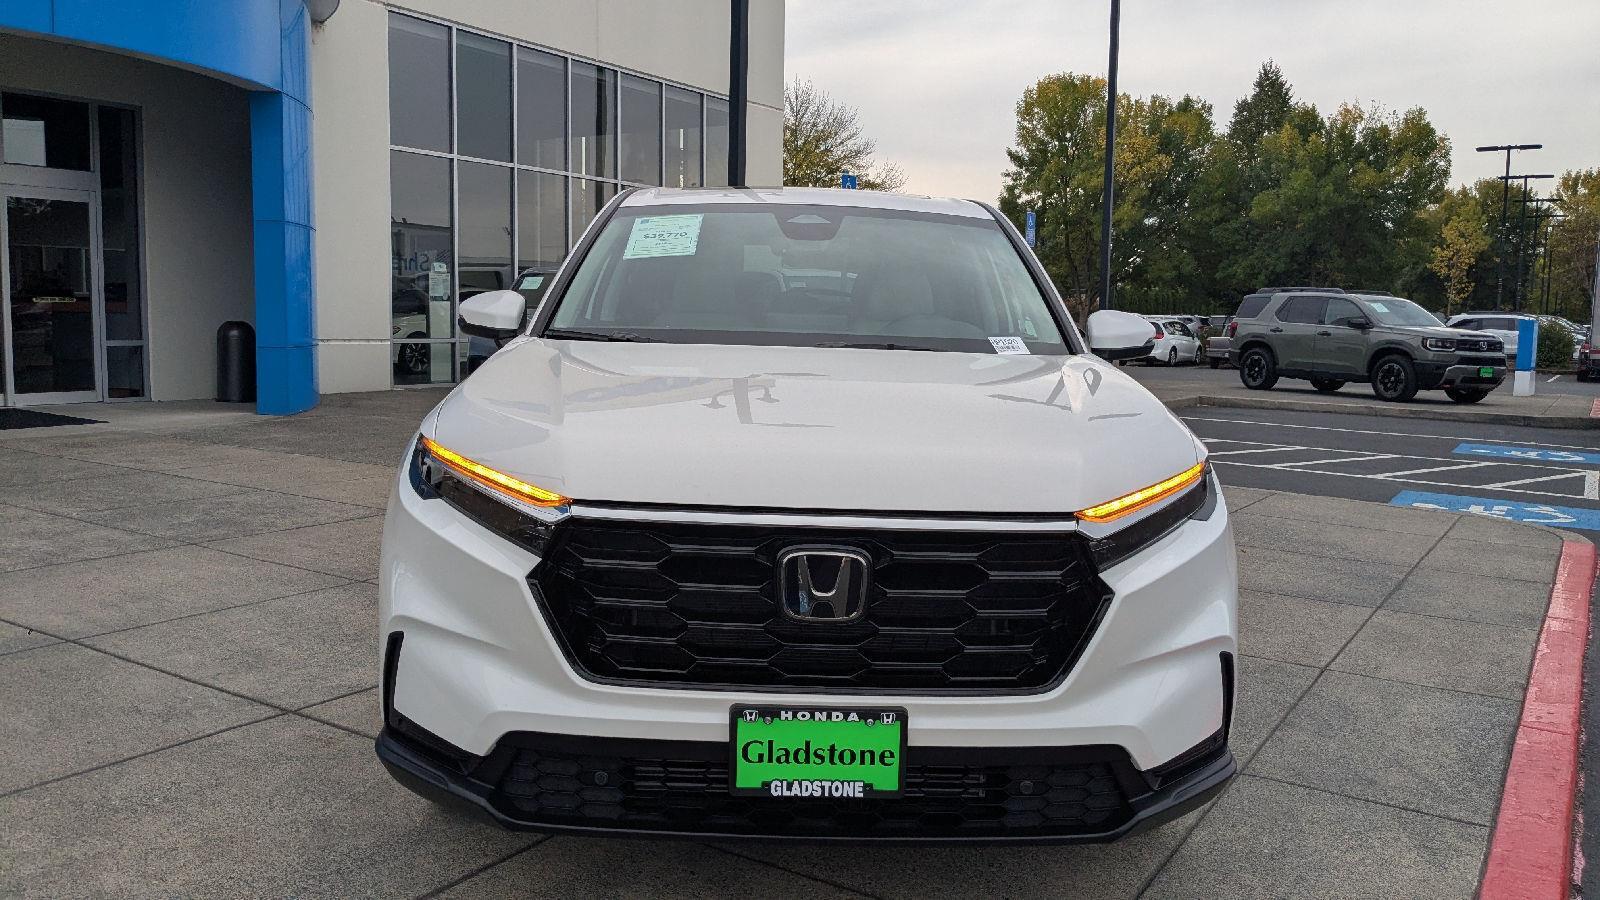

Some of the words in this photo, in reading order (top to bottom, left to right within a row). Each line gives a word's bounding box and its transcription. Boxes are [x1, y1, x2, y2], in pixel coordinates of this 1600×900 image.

[780, 711, 860, 722] HONDA
[741, 739, 896, 767] Gladstone
[770, 780, 864, 798] GLADSTONE
